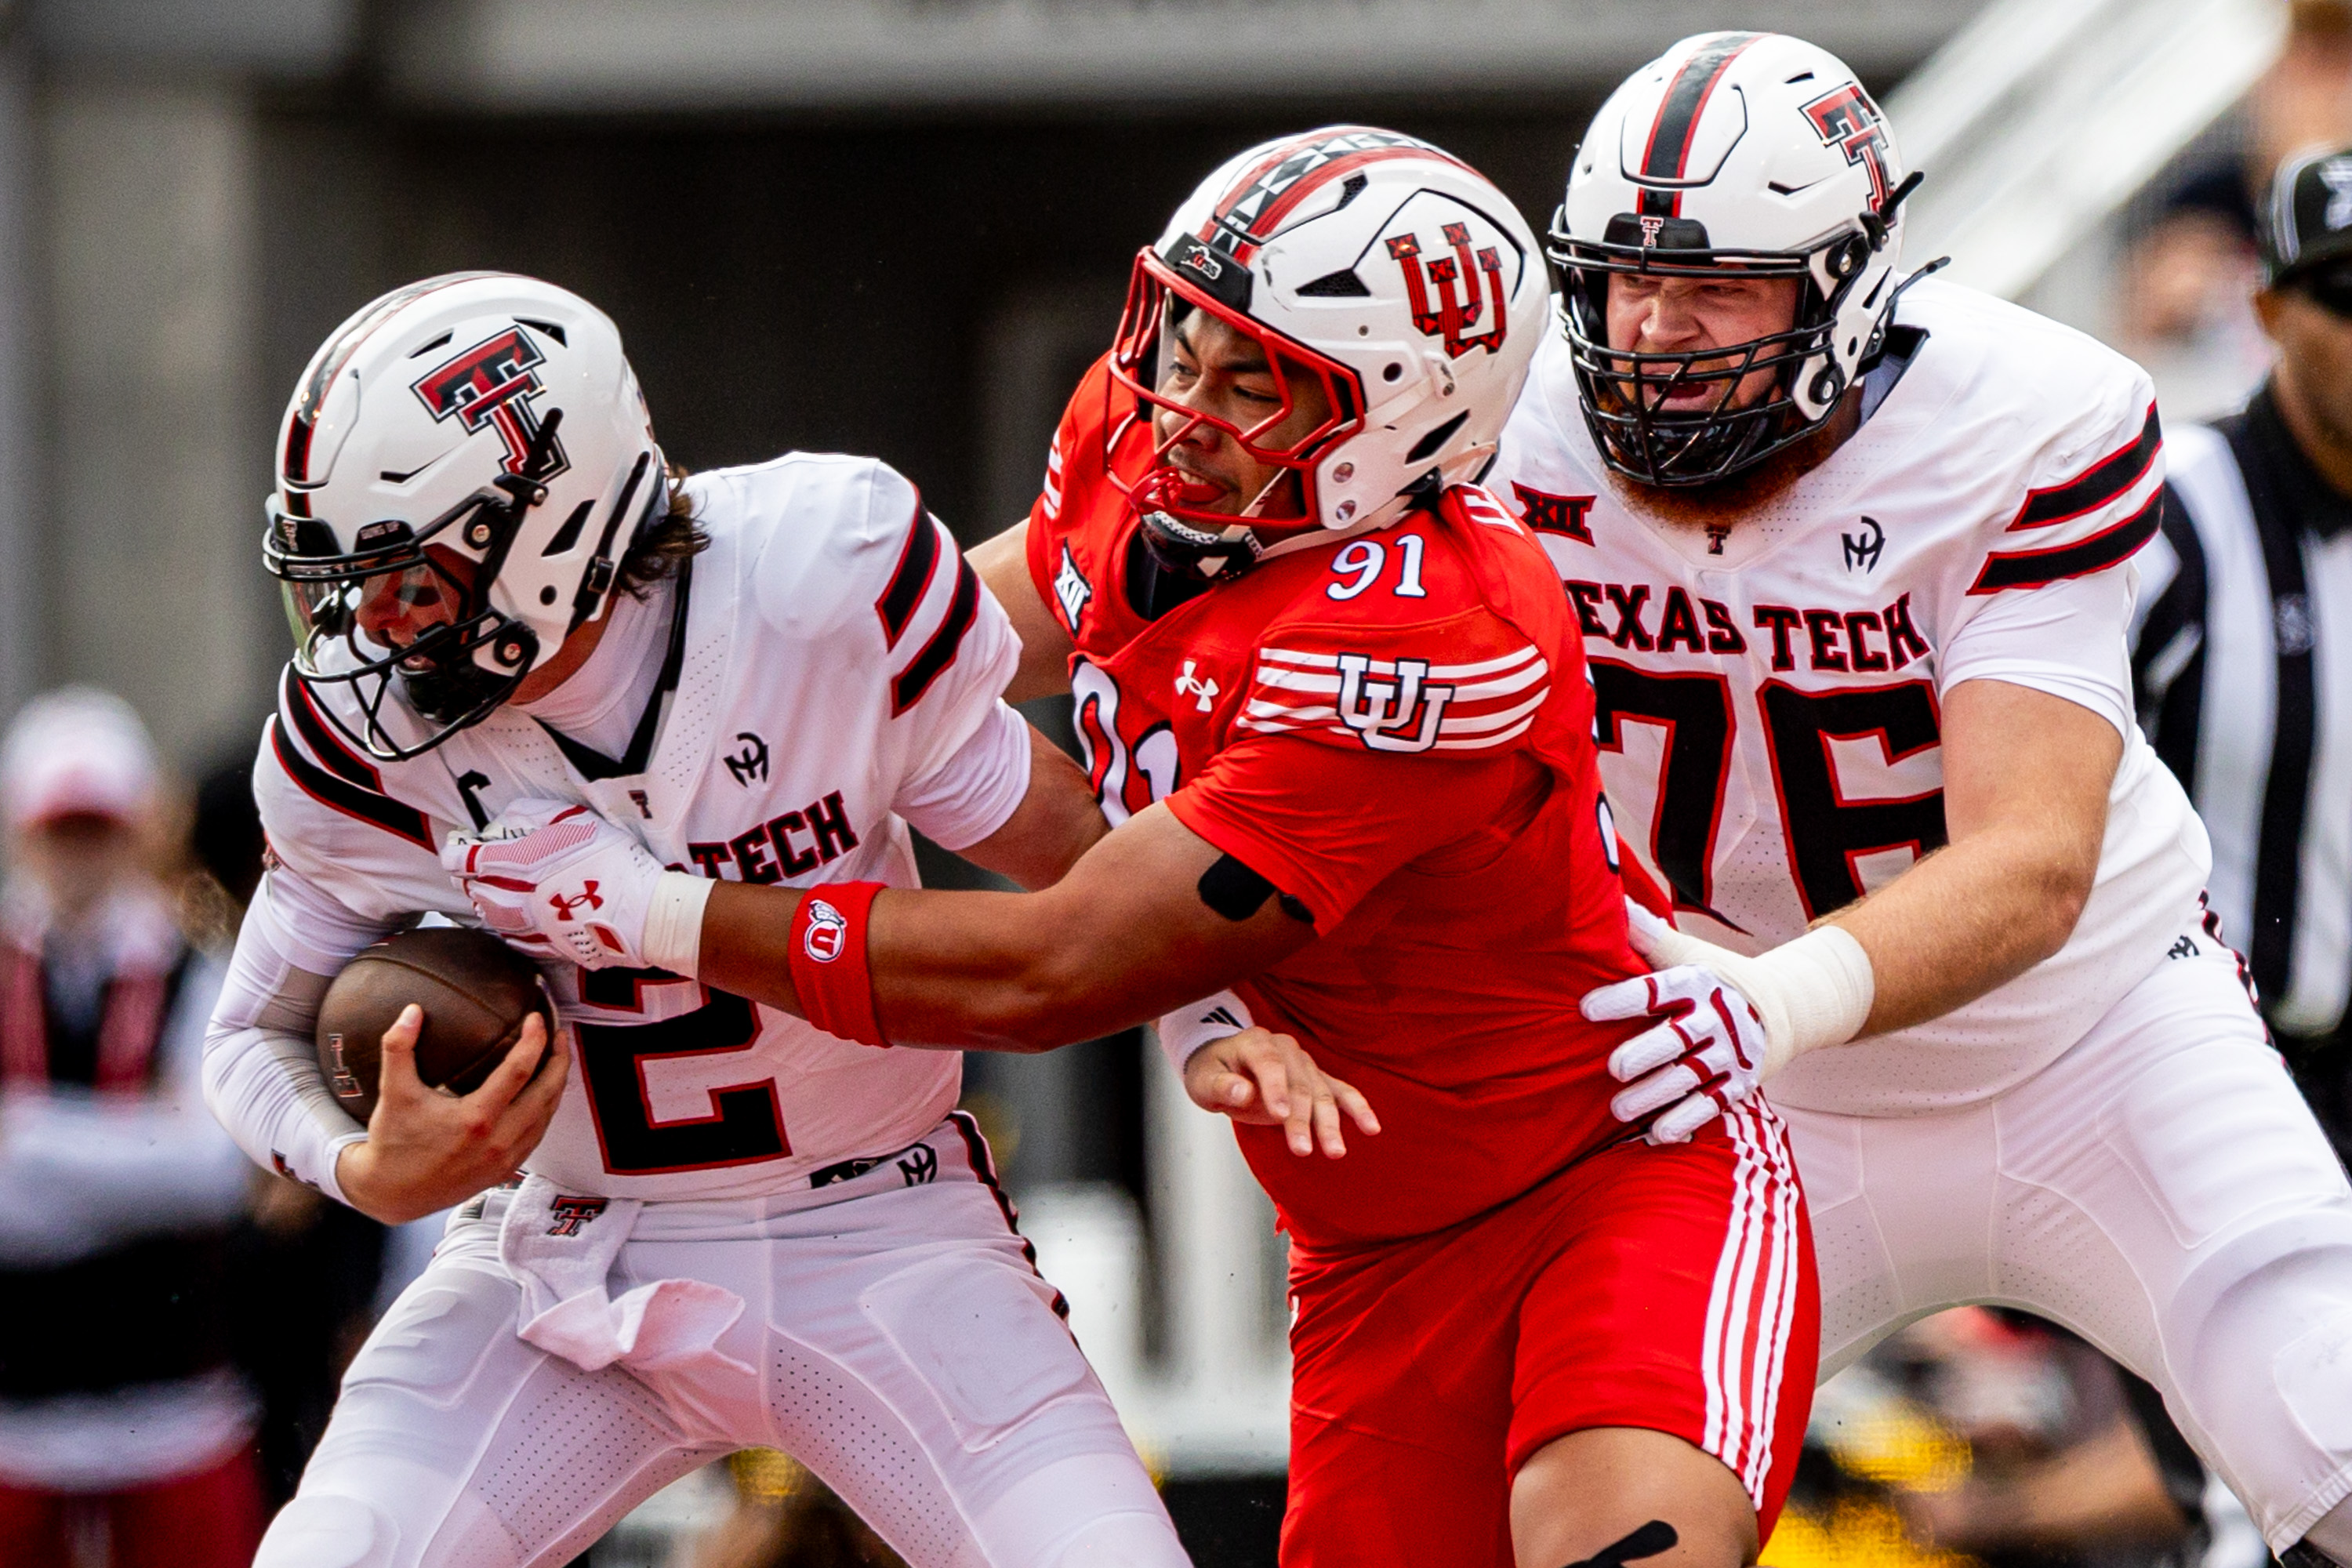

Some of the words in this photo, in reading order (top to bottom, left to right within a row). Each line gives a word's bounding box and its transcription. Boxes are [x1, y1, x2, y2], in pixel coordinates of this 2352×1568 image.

[1327, 533, 1428, 602] 91
[1565, 579, 1748, 655] EXAS
[1753, 591, 1931, 673] TECH
[687, 789, 860, 886] TECH
[572, 964, 793, 1176] 2
